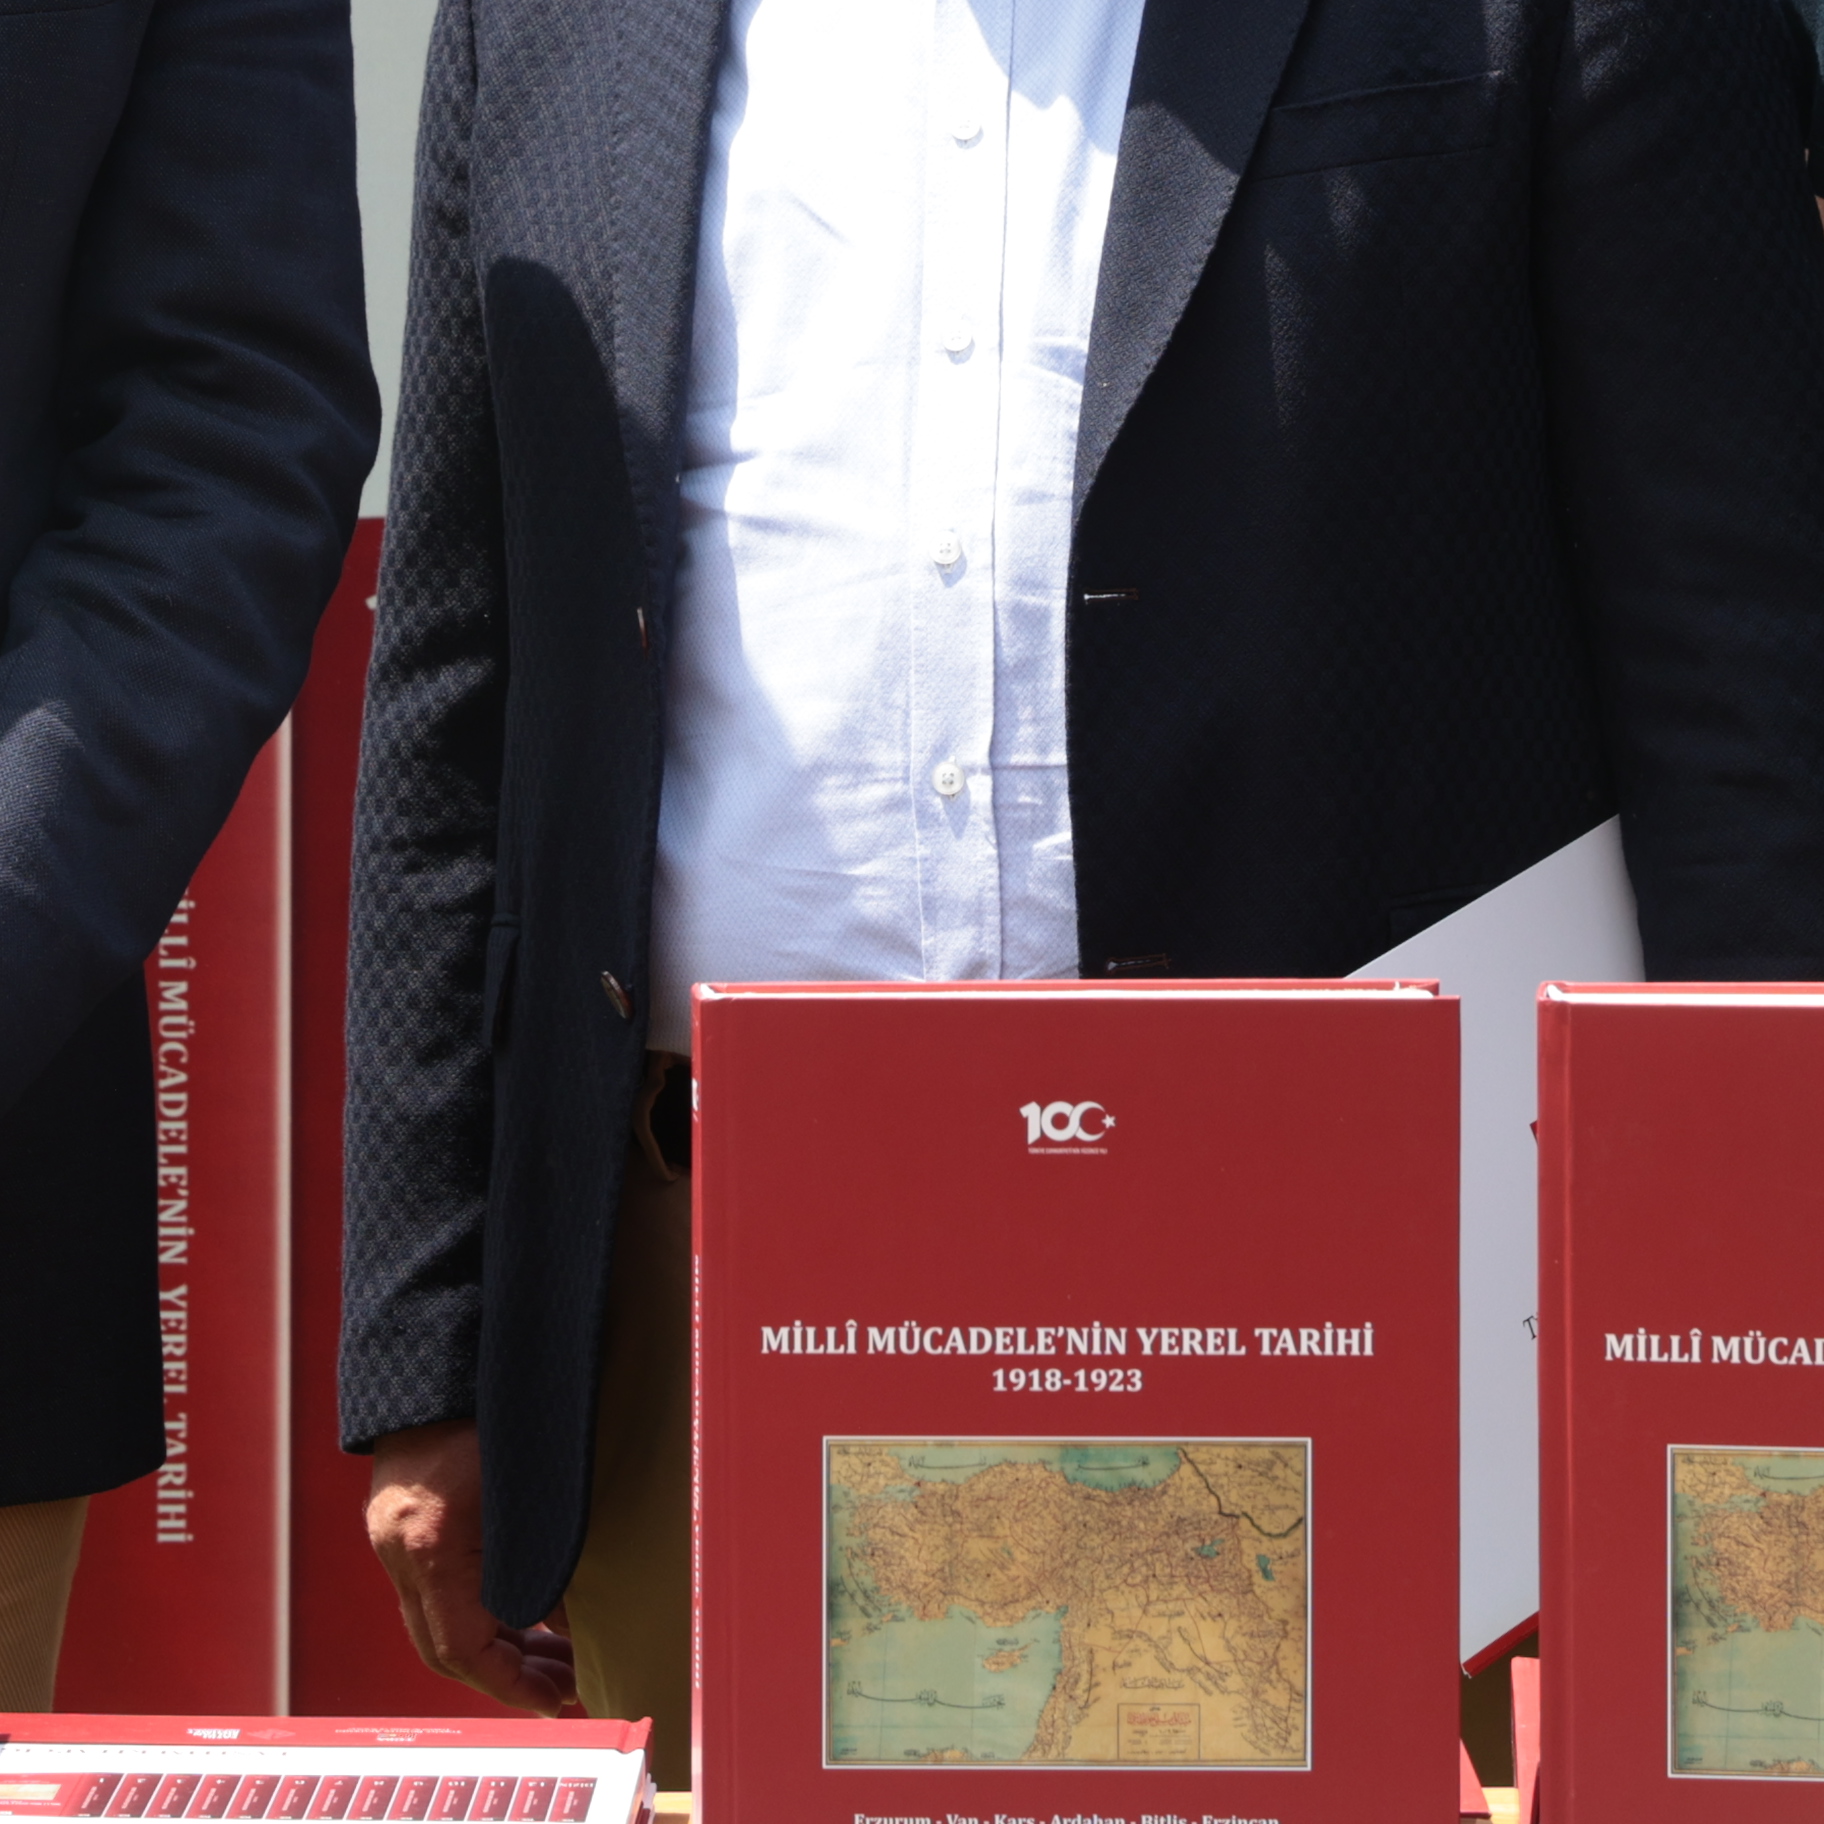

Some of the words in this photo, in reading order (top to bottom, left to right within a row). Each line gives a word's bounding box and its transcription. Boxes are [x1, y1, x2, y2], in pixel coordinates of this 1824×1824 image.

[761, 1319, 858, 1354] MİLLÎ
[1136, 1327, 1246, 1356] YEREL
[1254, 1321, 1374, 1356] TARİHİ
[1605, 1327, 1702, 1363] MİLLÎ
[993, 1368, 1143, 1392] 1918-1923
